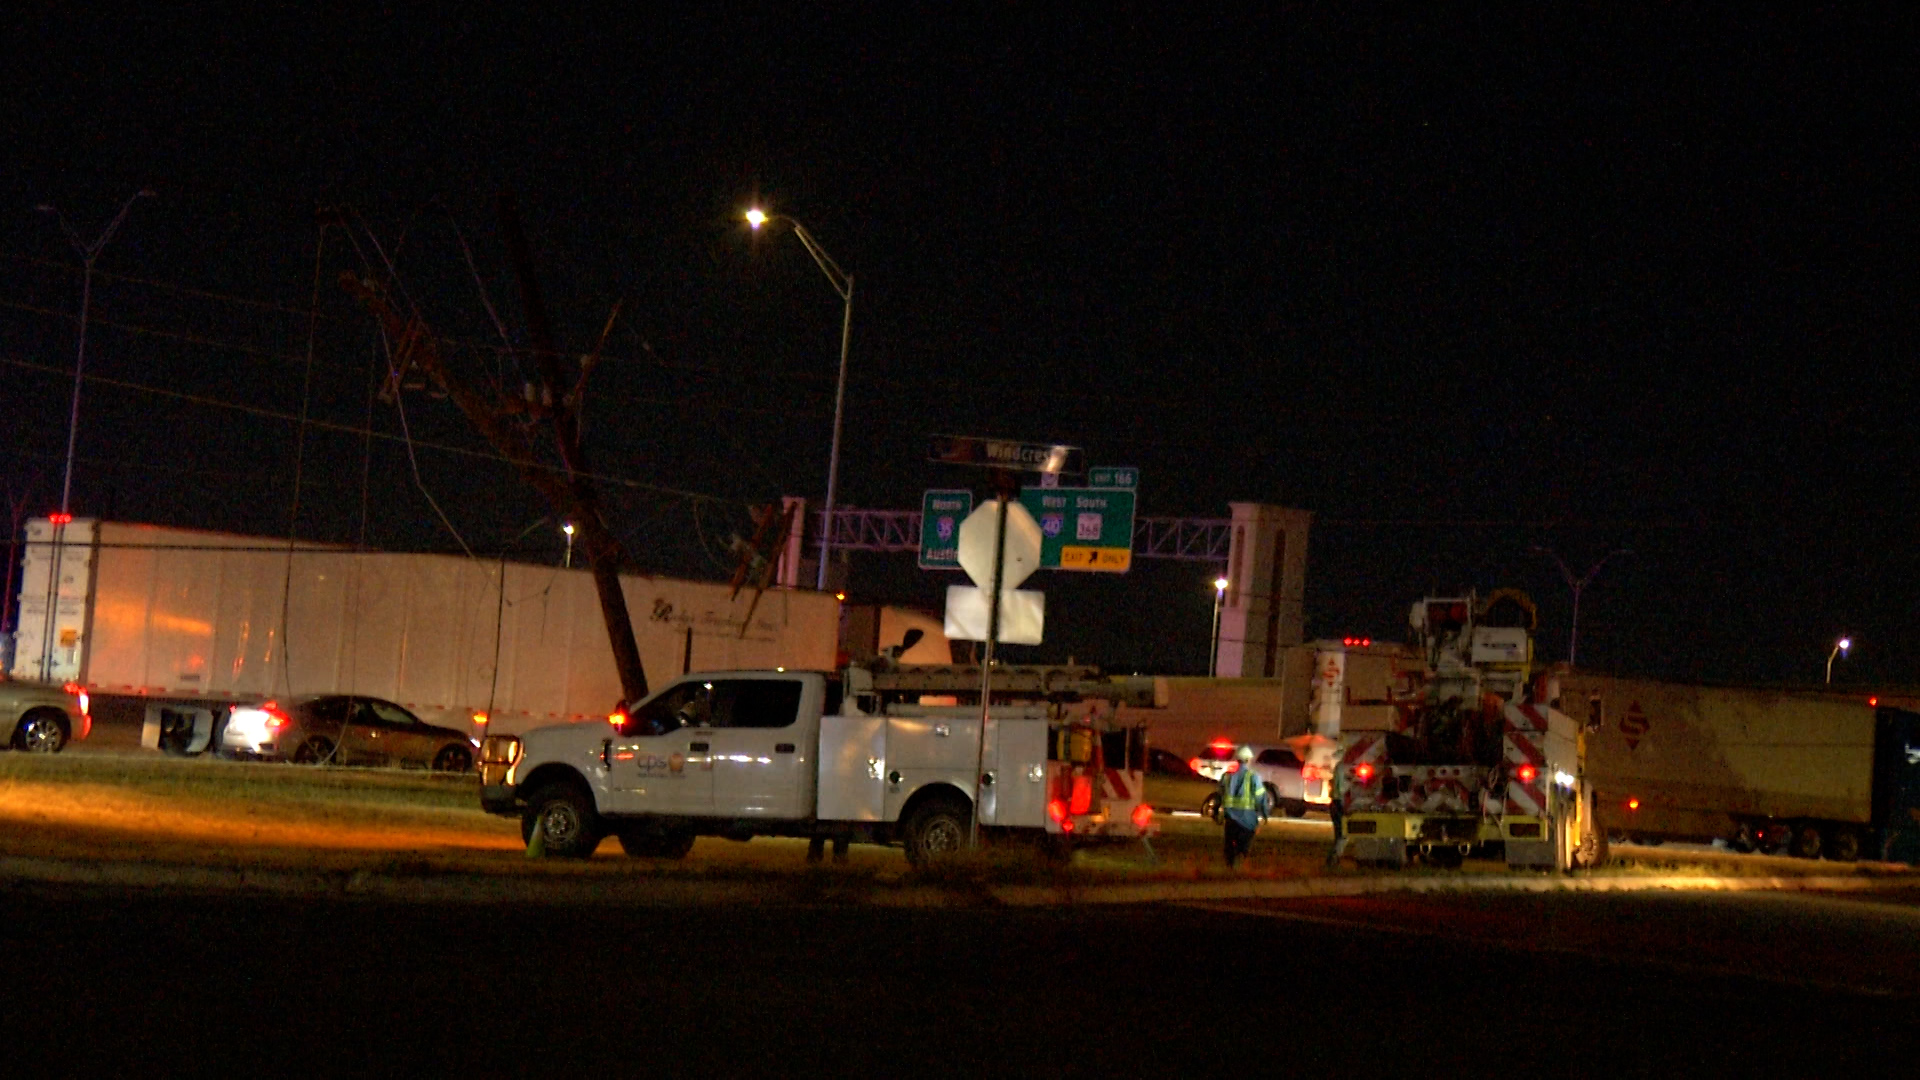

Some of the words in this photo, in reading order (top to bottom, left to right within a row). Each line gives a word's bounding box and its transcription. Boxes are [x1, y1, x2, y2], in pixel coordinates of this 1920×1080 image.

[987, 442, 1055, 463] Windcres
[1114, 472, 1133, 484] 166
[1064, 552, 1083, 562] EXIT
[1102, 554, 1126, 564] ONLY
